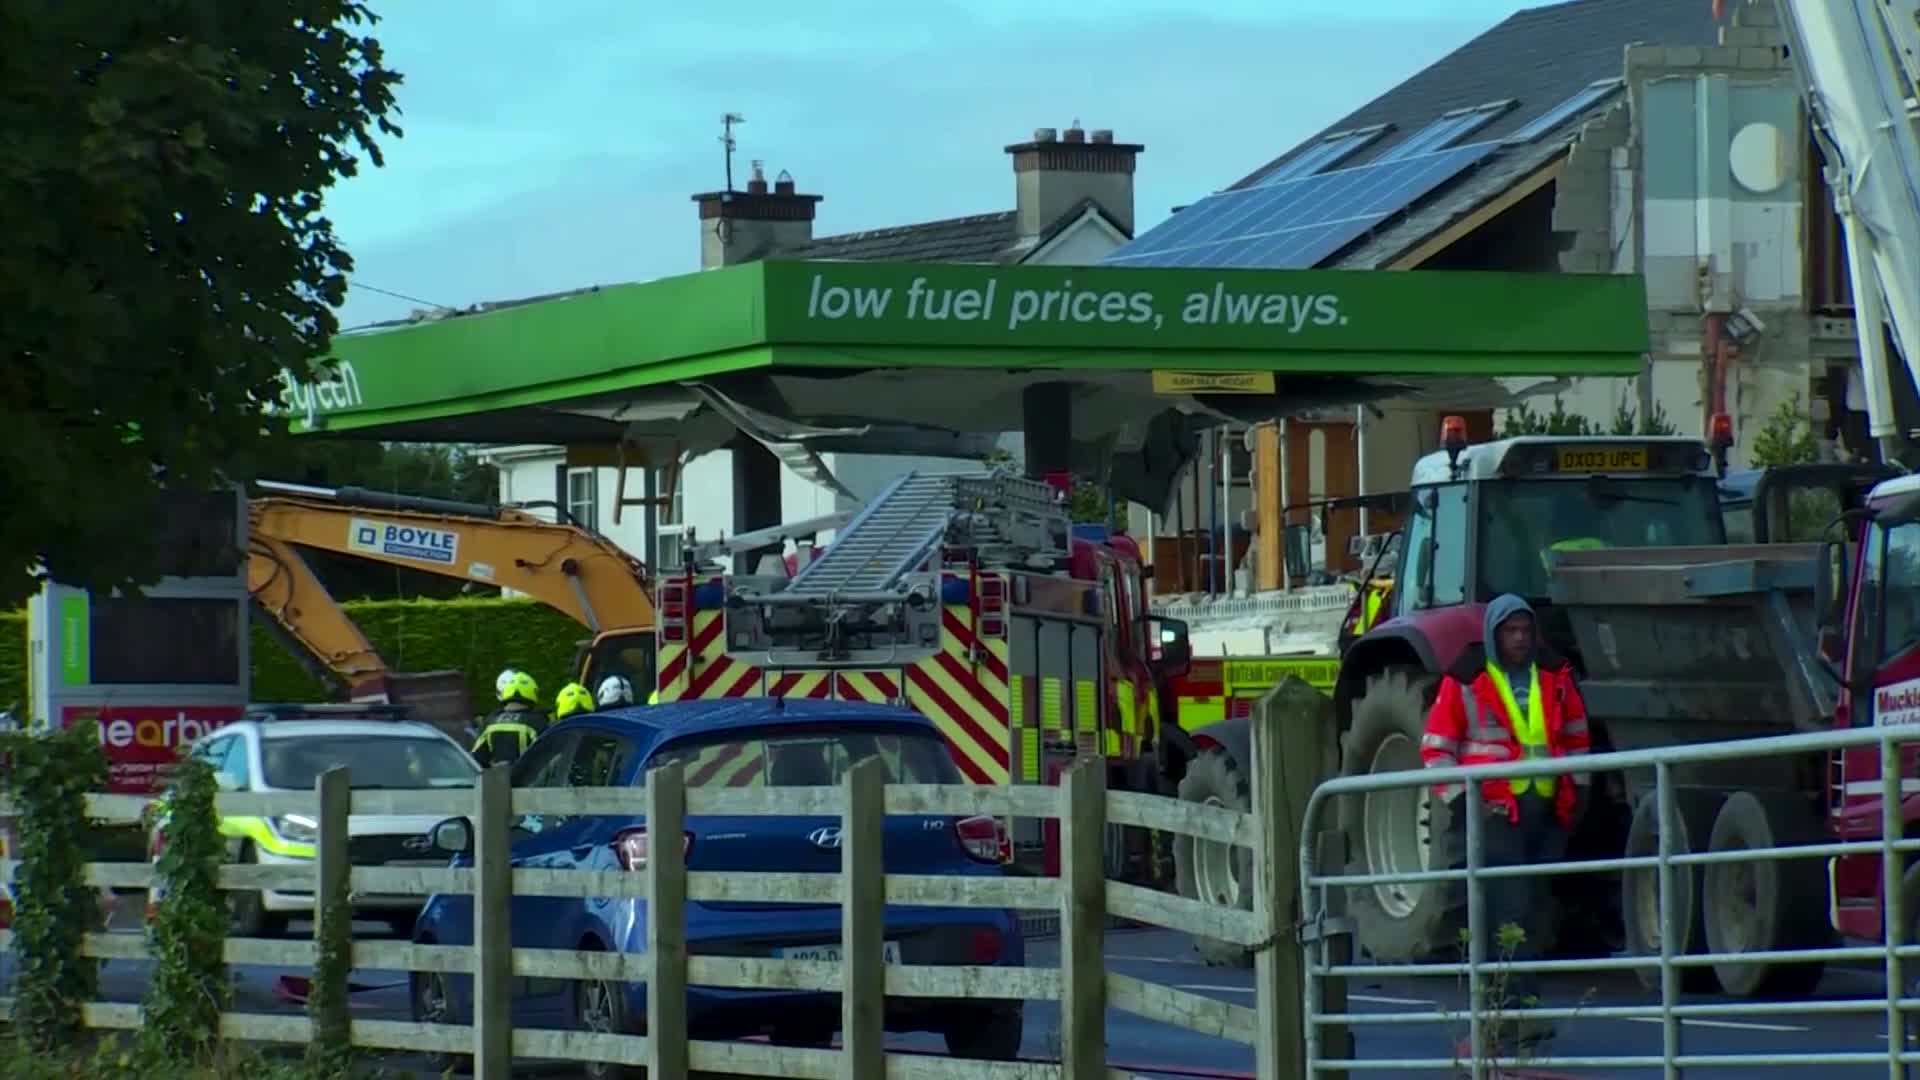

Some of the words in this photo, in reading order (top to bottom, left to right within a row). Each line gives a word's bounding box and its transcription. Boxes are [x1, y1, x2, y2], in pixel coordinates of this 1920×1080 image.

[808, 274, 891, 319] low
[906, 278, 997, 322] fuel
[1008, 280, 1165, 330] prices,
[1182, 282, 1350, 334] always.
[384, 525, 455, 550] BOYLE
